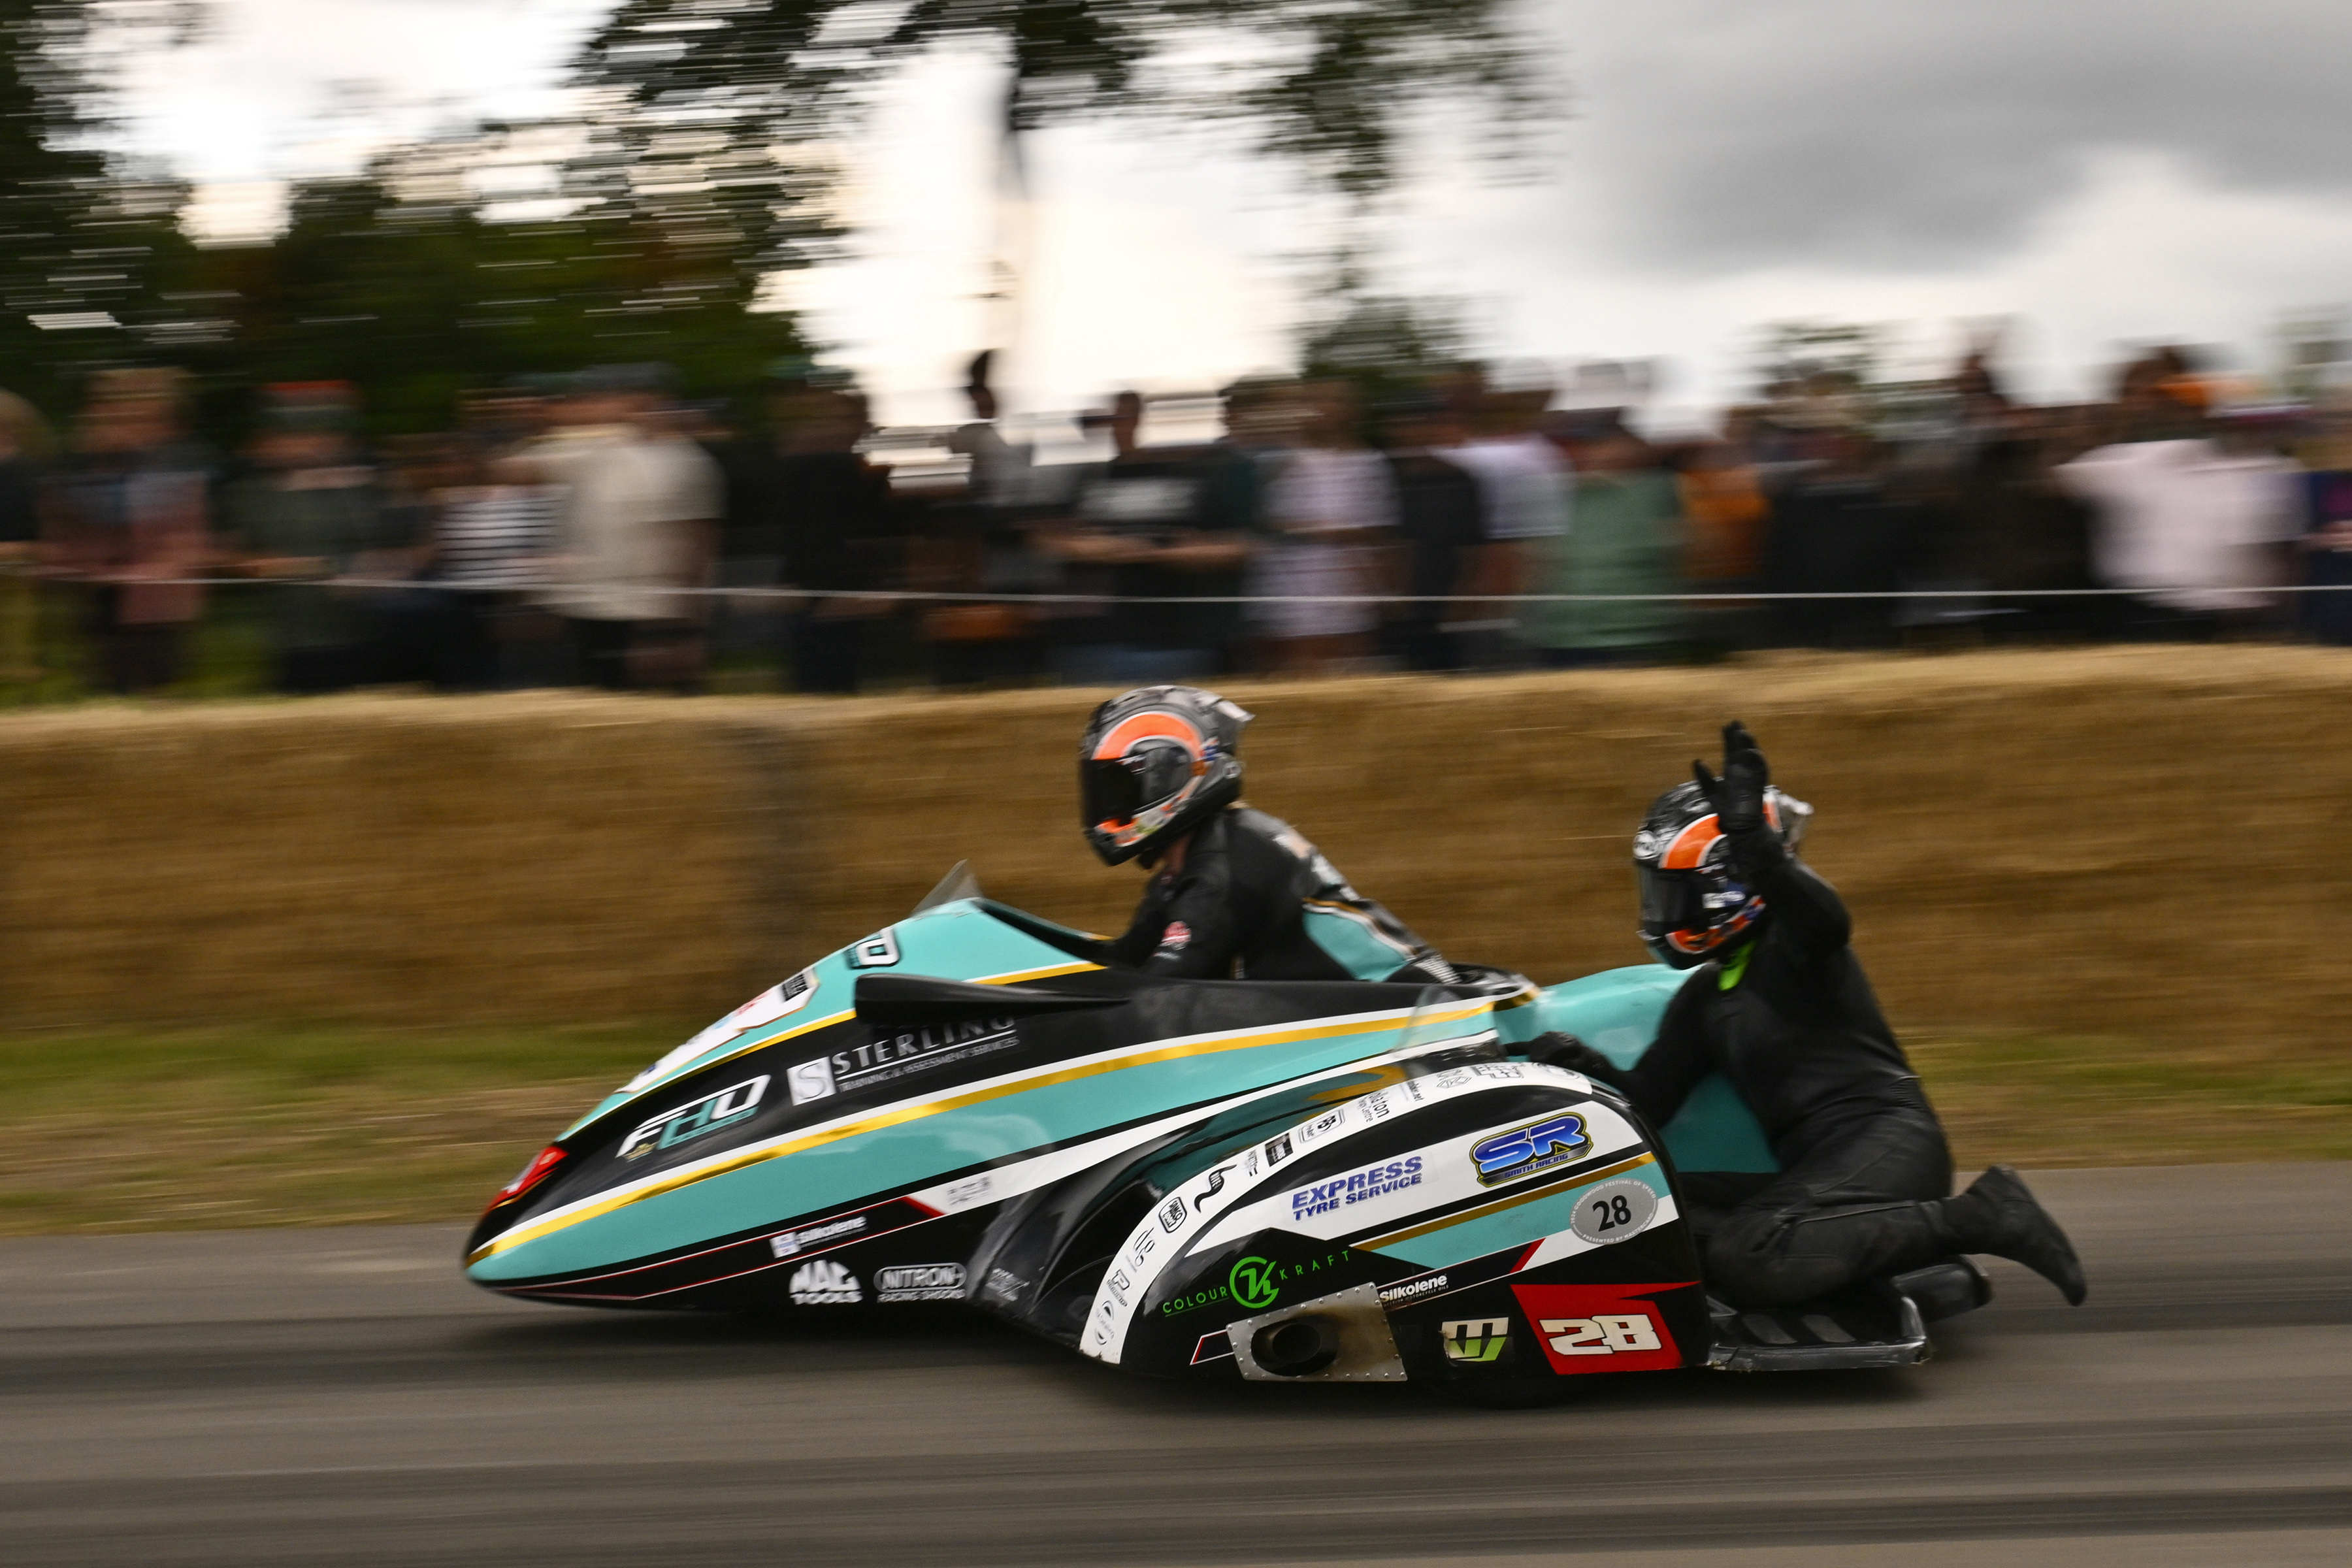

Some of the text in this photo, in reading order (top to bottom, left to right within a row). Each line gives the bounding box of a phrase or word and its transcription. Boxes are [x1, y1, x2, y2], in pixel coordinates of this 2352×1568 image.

[832, 1017, 1015, 1074] STERLING
[1473, 1115, 1586, 1173] SR
[1292, 1156, 1423, 1209] EXPRESS
[1505, 1153, 1569, 1179] SMITH RACING
[1293, 1173, 1422, 1221] TYRE SERVICE
[1574, 1184, 1604, 1210] GOODWOOD
[1642, 1183, 1657, 1199] SPEED
[1592, 1195, 1632, 1232] 28
[1582, 1233, 1614, 1243] PRESENTED
[1624, 1213, 1654, 1239] MASTERCARD
[791, 1290, 864, 1305] TOOLS
[1162, 1286, 1228, 1314] COLOUR
[1279, 1250, 1349, 1281] KRAFT
[1379, 1275, 1448, 1303] Silkolene
[1405, 1289, 1436, 1301] MOTORCYCLE
[1539, 1314, 1662, 1355] 28
